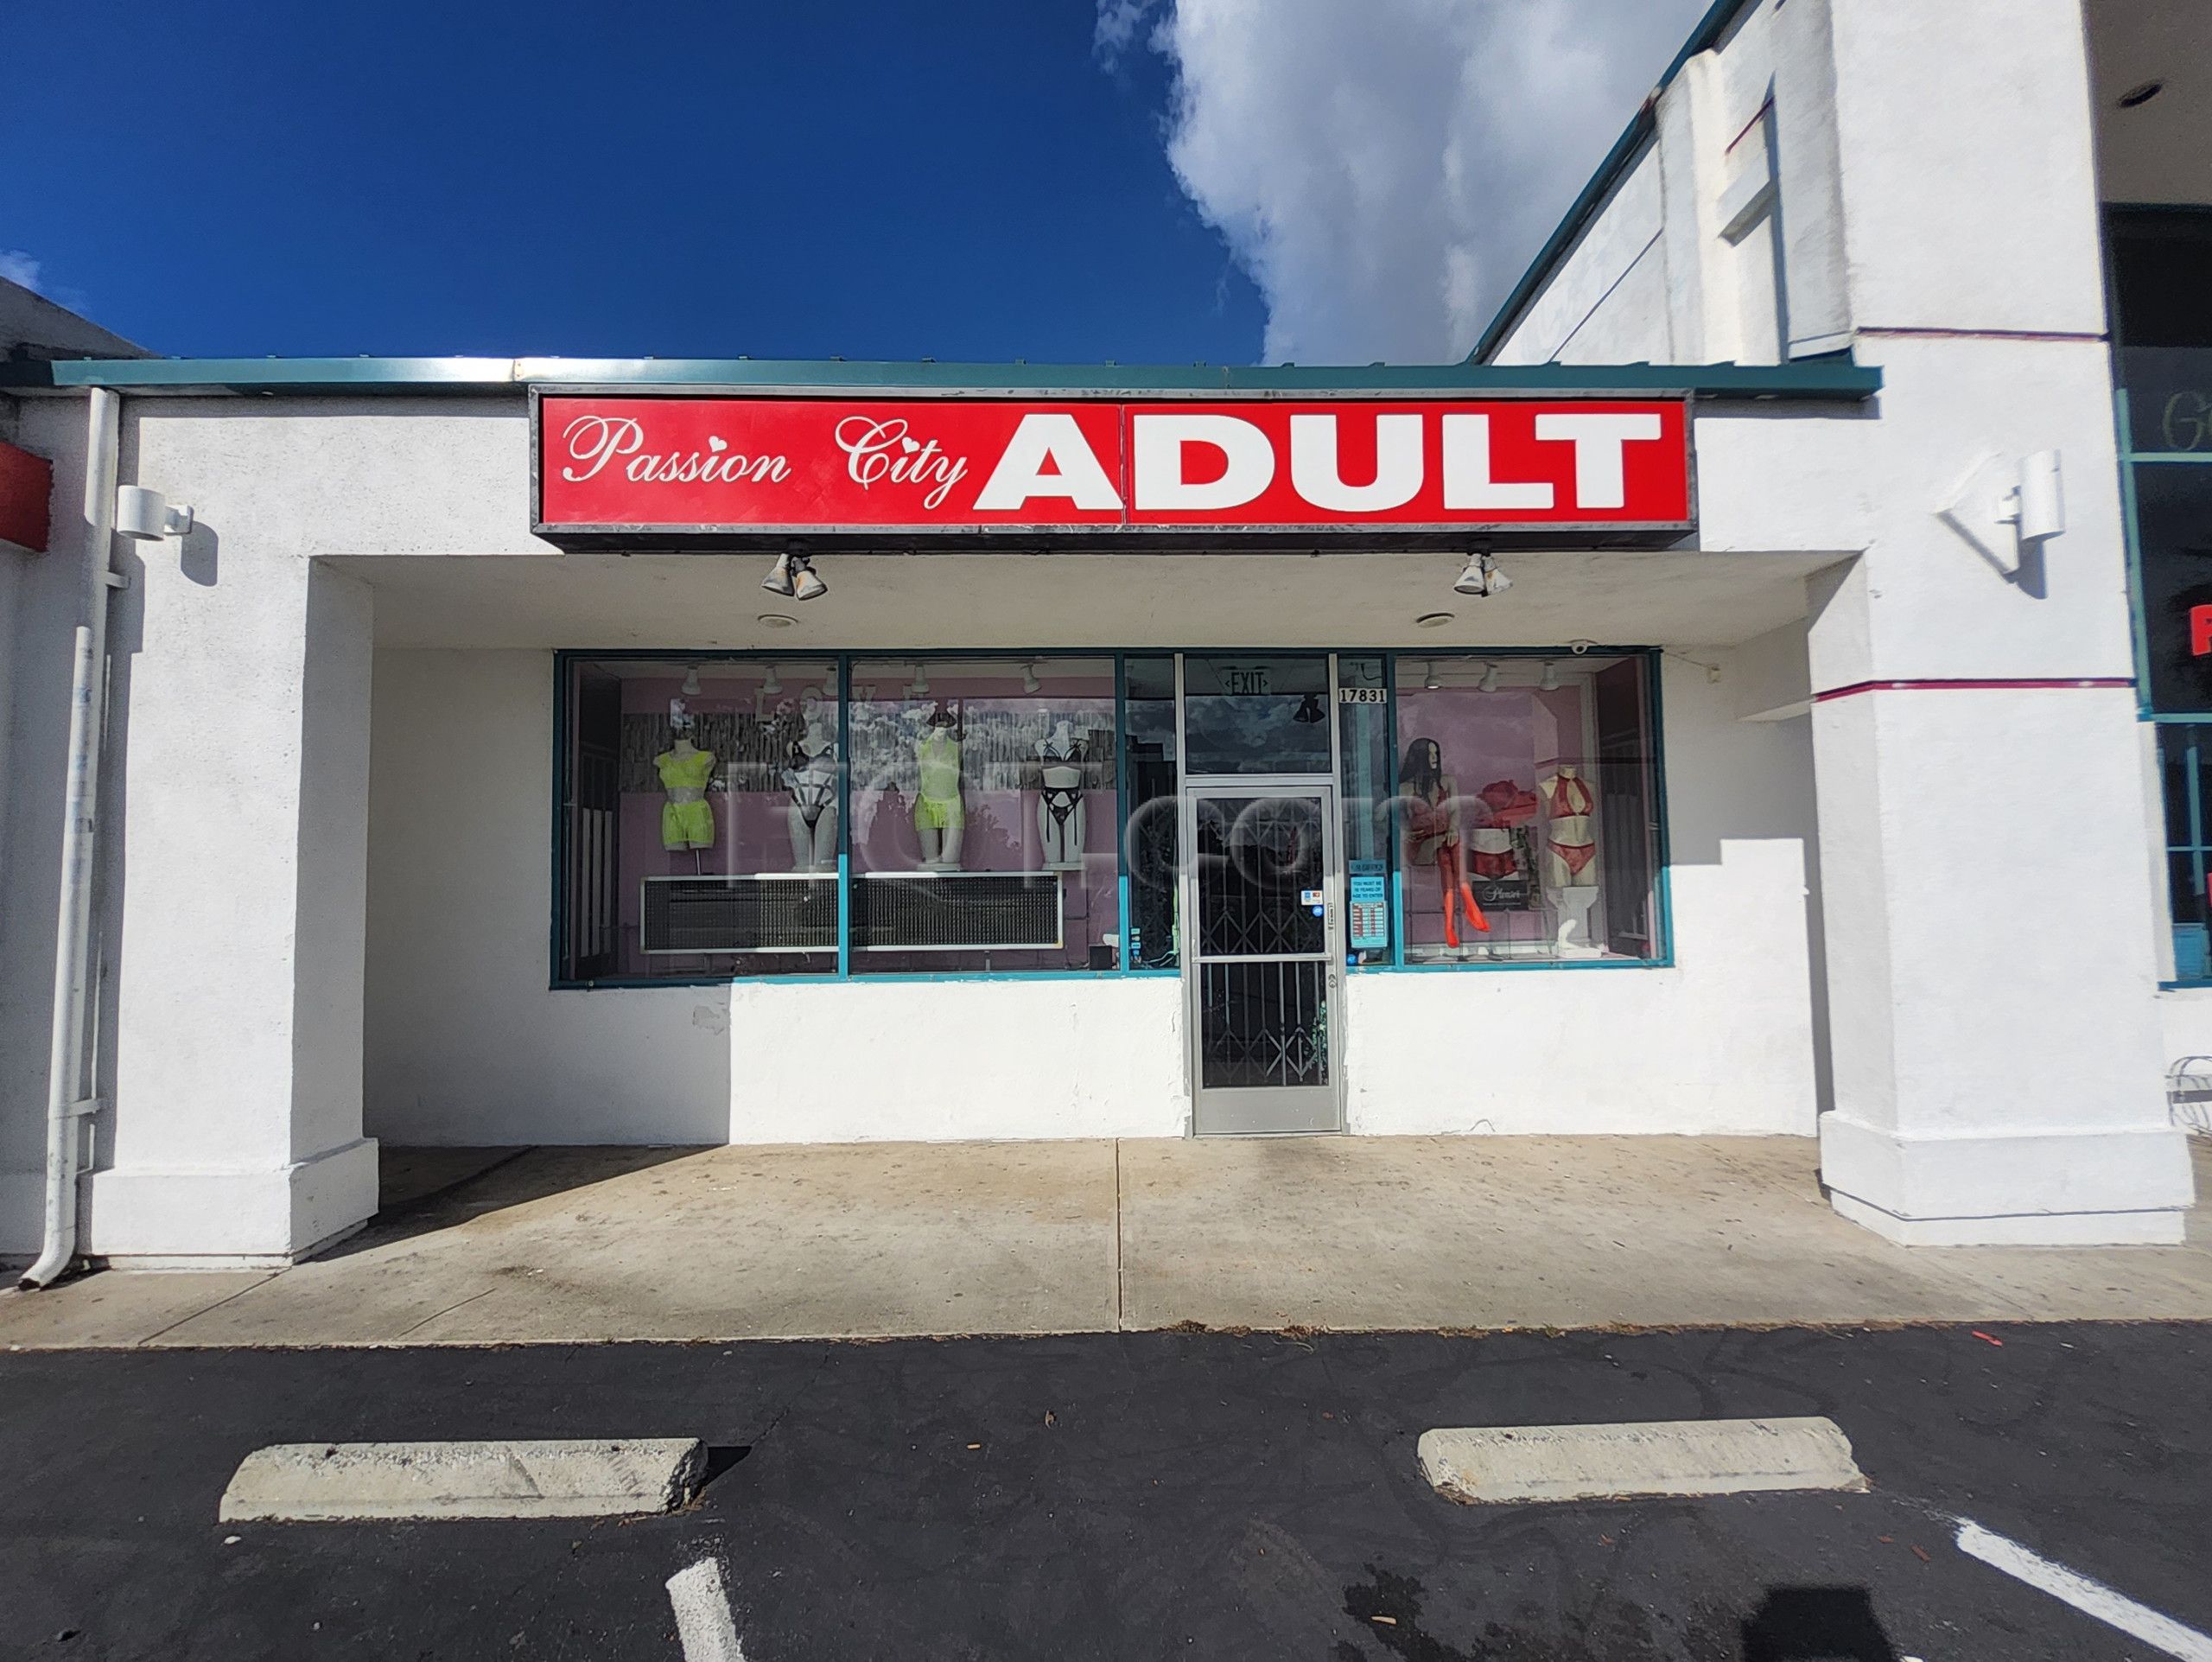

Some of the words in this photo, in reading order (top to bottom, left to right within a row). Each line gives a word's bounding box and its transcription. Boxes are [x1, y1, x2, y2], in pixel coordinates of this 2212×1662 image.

[563, 415, 791, 482] Passion
[835, 416, 968, 510] City
[973, 413, 1662, 513] ADULT
[1230, 672, 1264, 694] EXIT
[1340, 689, 1385, 703] 17831
